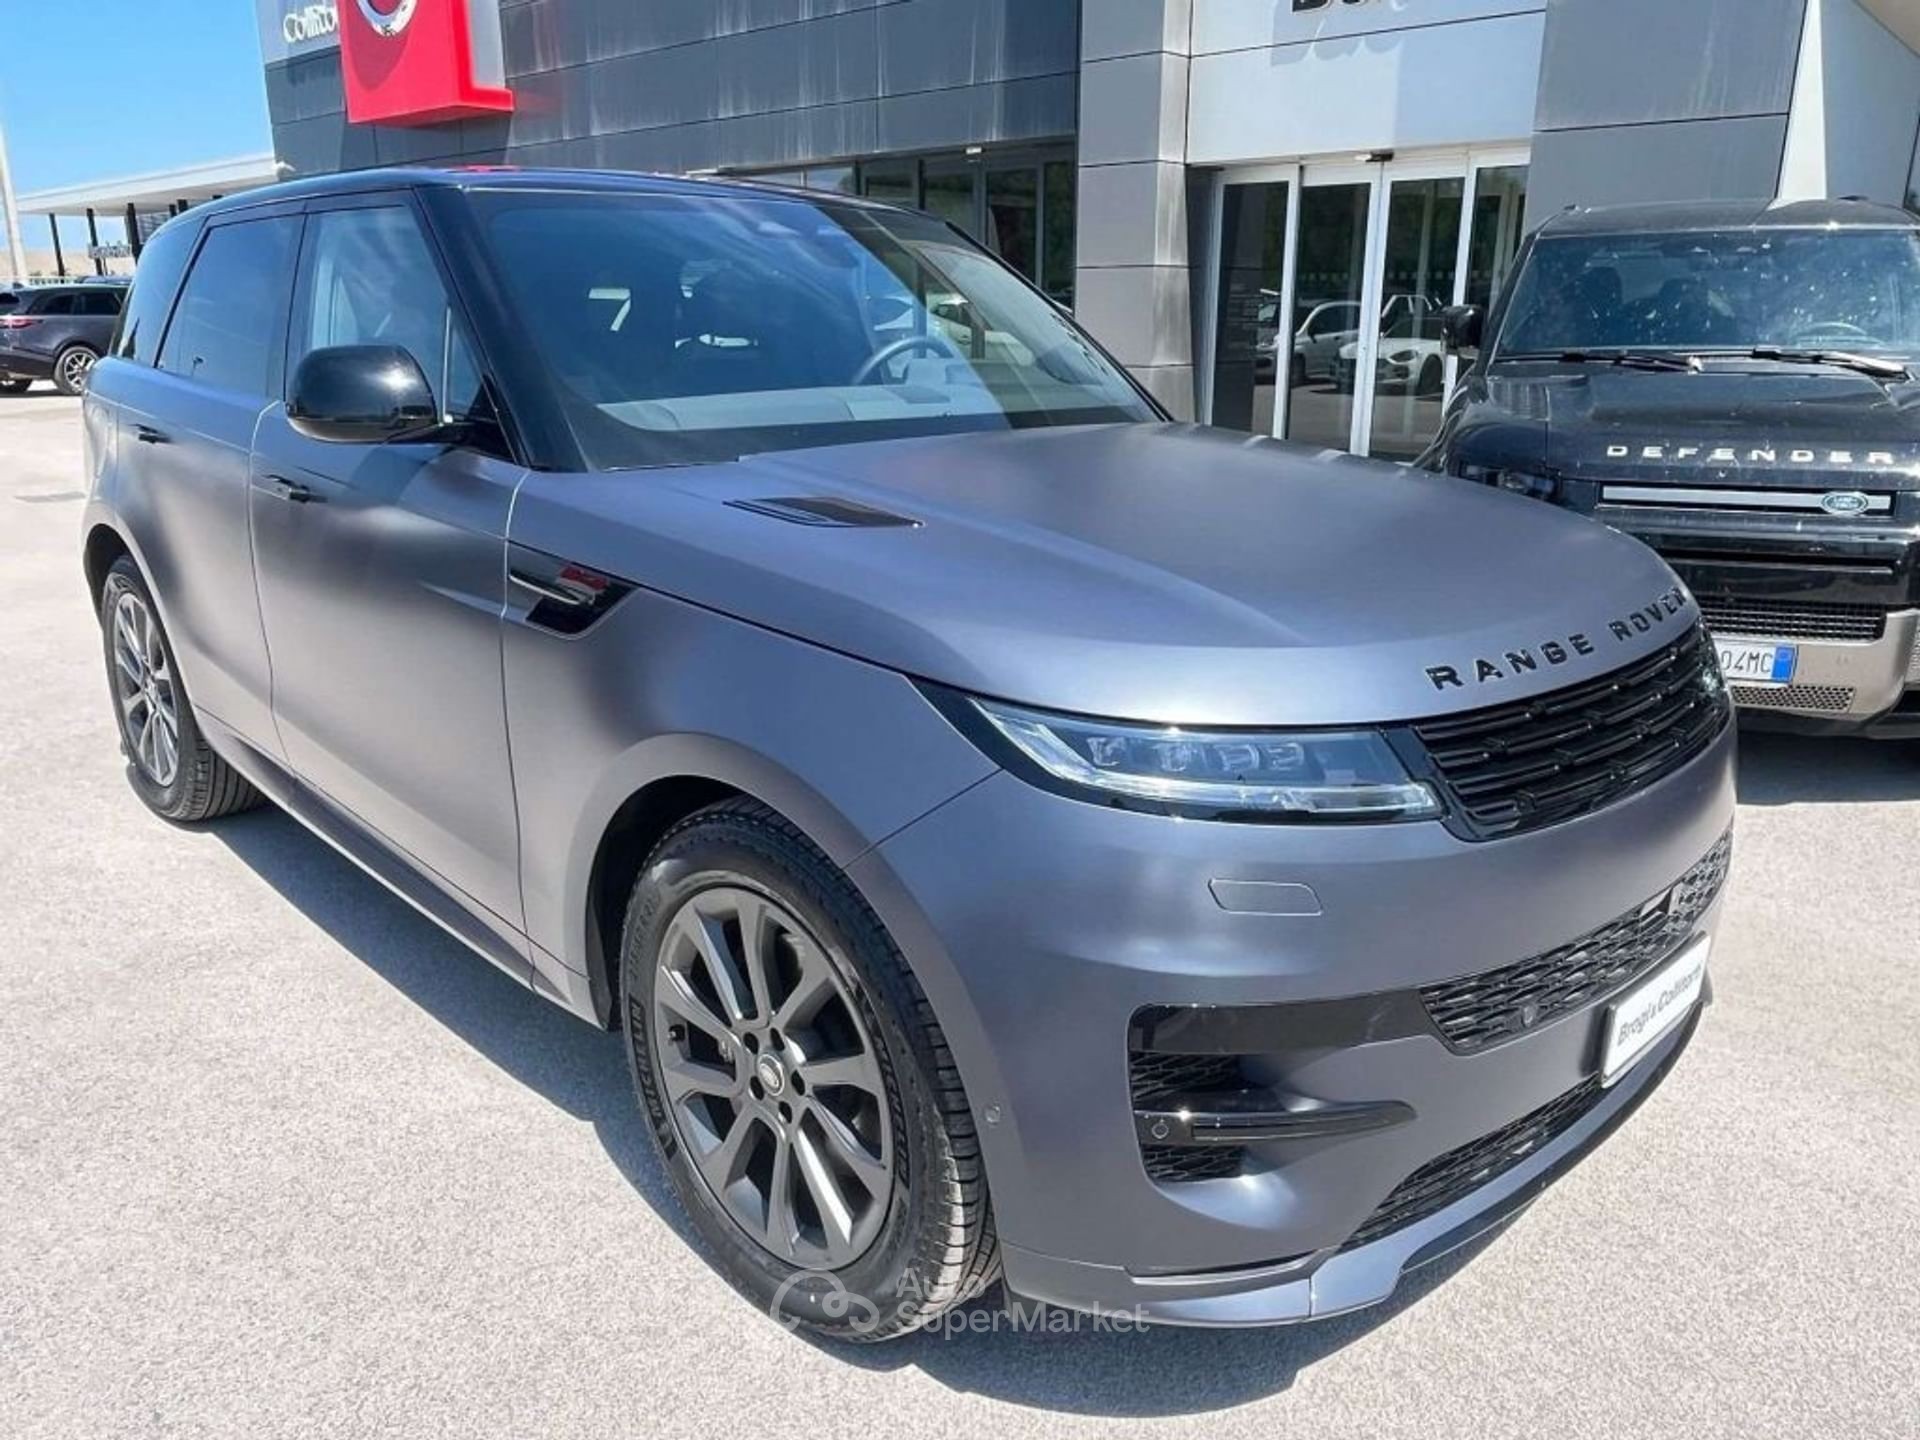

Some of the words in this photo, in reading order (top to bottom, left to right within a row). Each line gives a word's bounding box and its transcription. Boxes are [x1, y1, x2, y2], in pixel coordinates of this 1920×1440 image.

[1606, 445, 1895, 465] DEFENDER
[1425, 633, 1595, 691] RANGE
[1609, 587, 1688, 641] ROVER
[631, 1003, 663, 1119] MICHELIN
